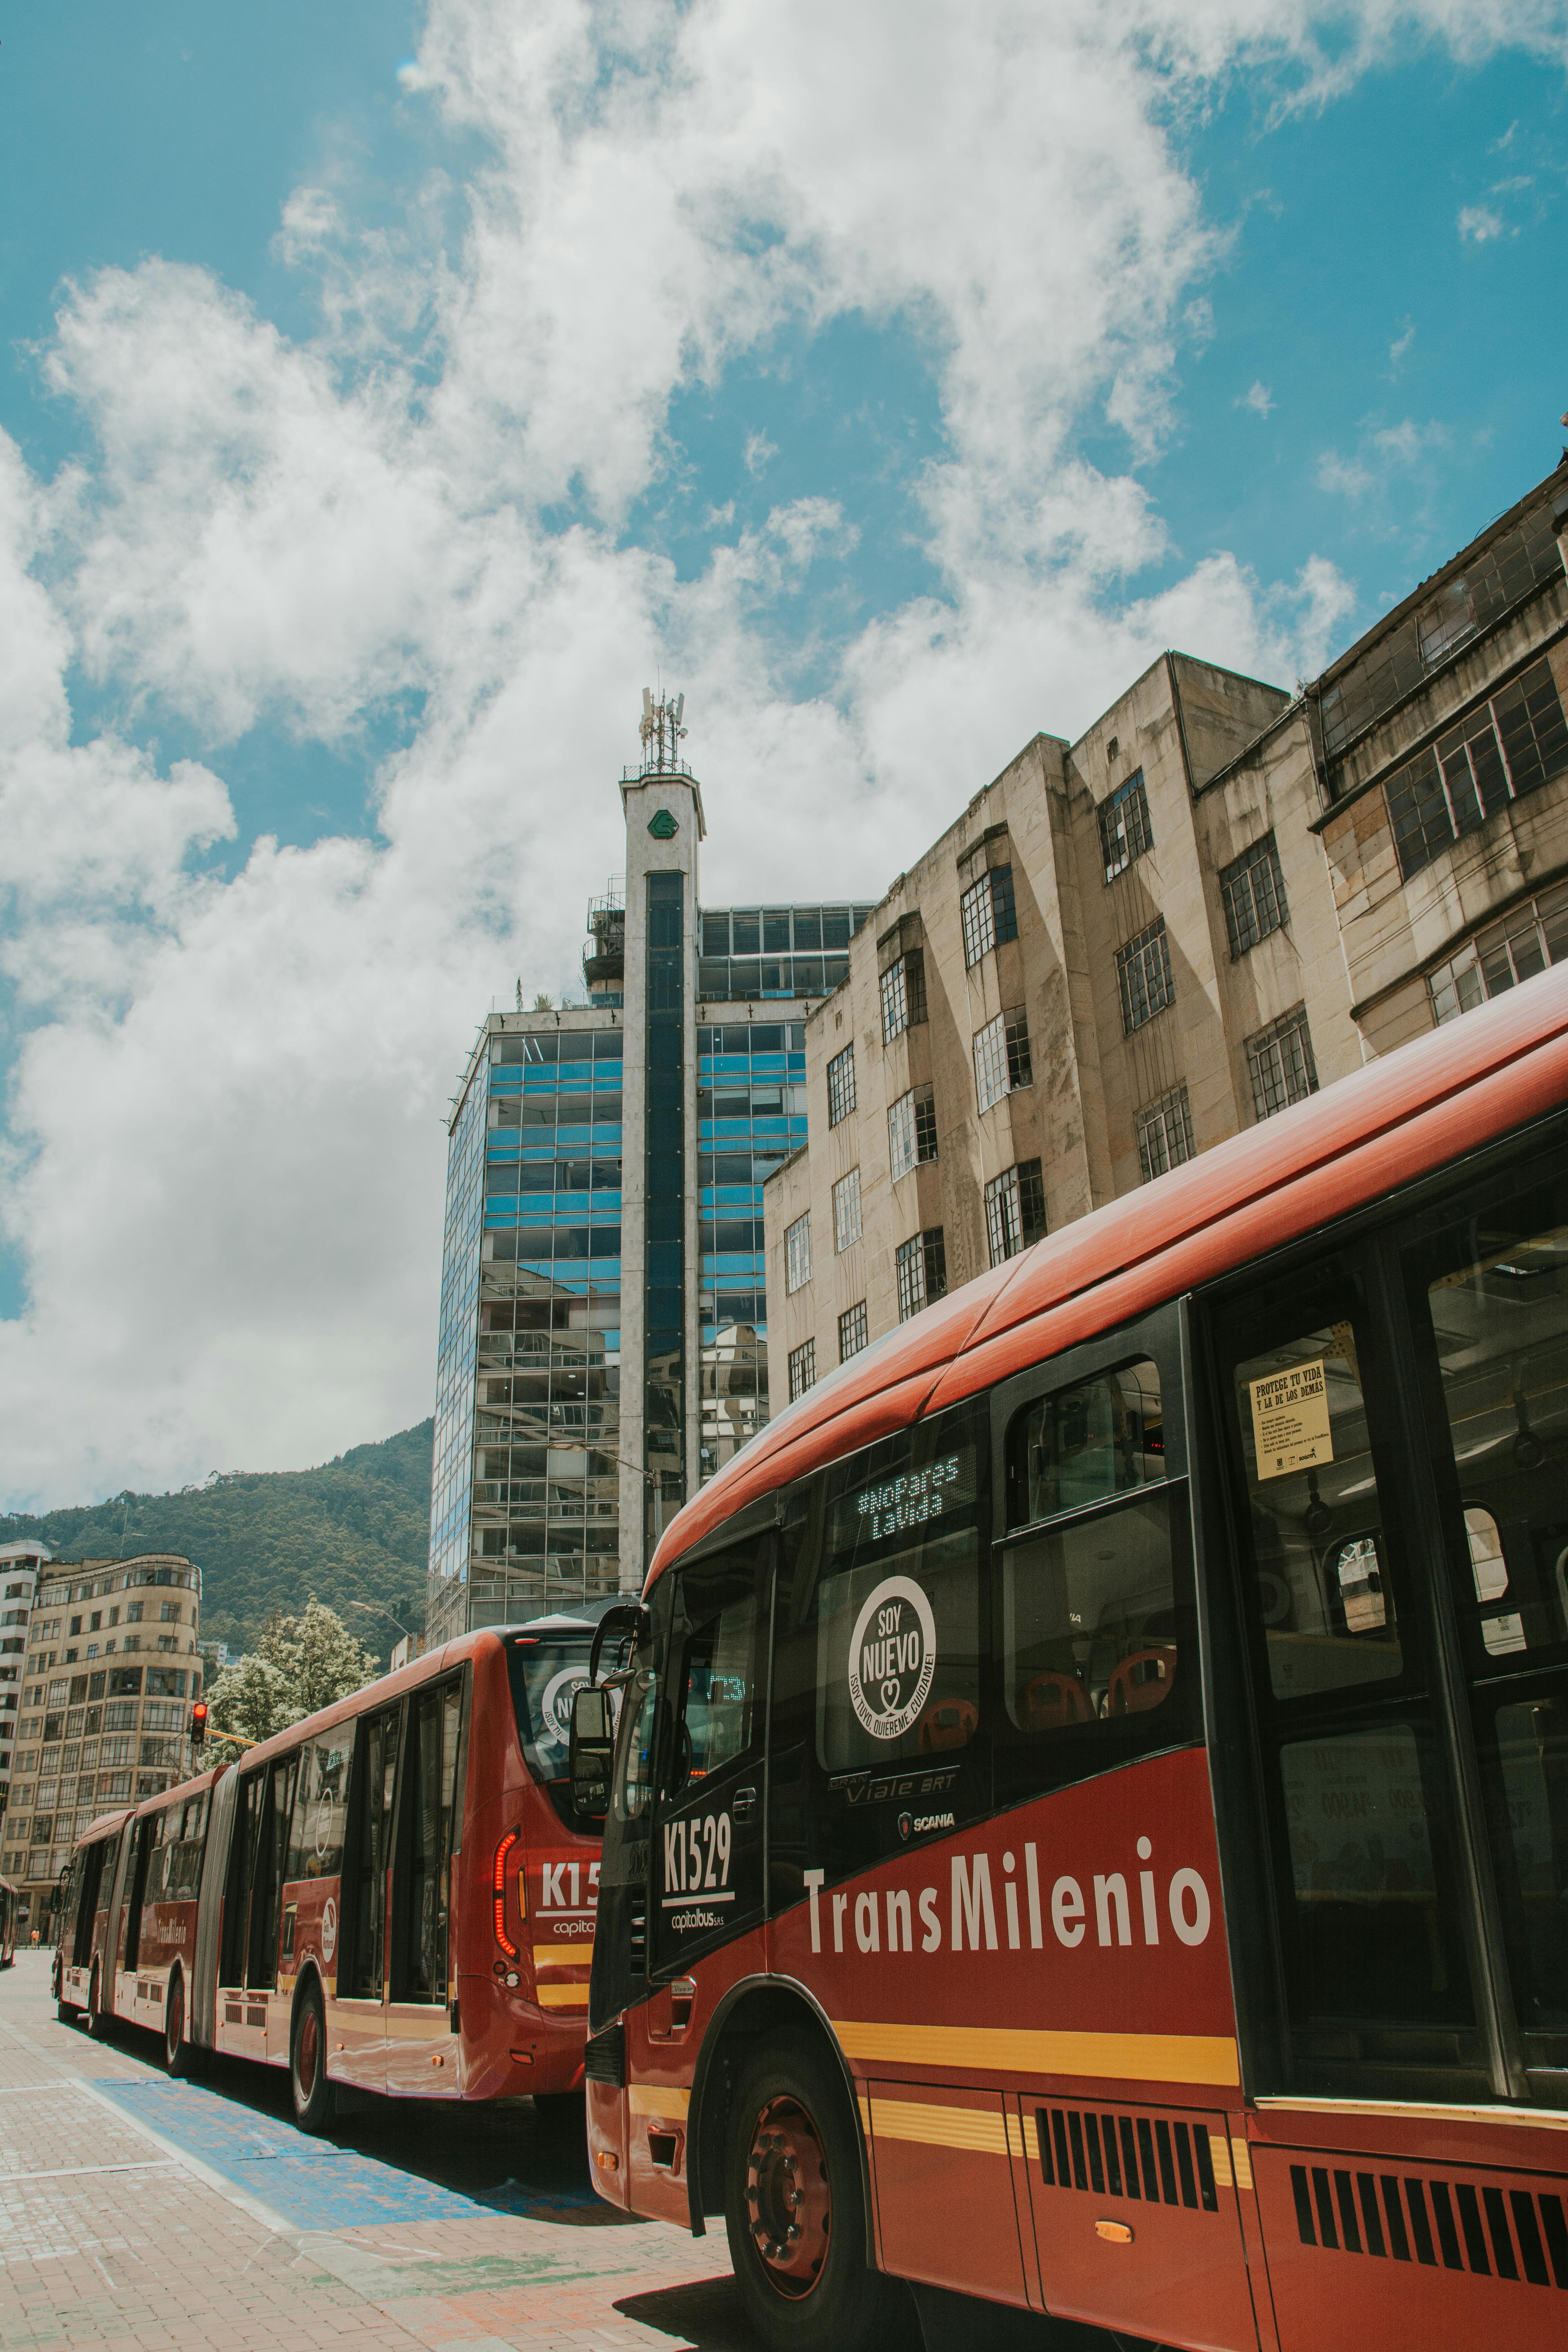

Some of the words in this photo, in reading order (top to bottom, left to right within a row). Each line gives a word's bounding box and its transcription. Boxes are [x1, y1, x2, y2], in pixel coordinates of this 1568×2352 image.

[1256, 1377, 1288, 1398] PROTEGE
[1290, 1373, 1300, 1387] TU
[1302, 1366, 1322, 1383] VIDA
[1257, 1400, 1261, 1411] Y
[1264, 1397, 1273, 1409] LA
[1275, 1393, 1283, 1405] DE
[1286, 1389, 1298, 1402] LOS
[1300, 1380, 1323, 1397] DEMÁS
[858, 1457, 958, 1514] #NoPares
[873, 1495, 942, 1539] LaVida
[878, 1604, 902, 1637] SOY
[863, 1630, 919, 1684] NUEVO
[850, 1673, 861, 1701] ¡SOY
[857, 1699, 873, 1730] TUYO,
[873, 1710, 913, 1736] QUIÉREME,
[911, 1653, 934, 1714] CUÍDAME!
[846, 1779, 913, 1803] Viale
[921, 1773, 956, 1793] BRT
[914, 1813, 955, 1831] SCANIA
[664, 1812, 731, 1893] K1529
[543, 1862, 601, 1906] K15
[804, 1836, 1211, 1954] TransMilenio
[157, 1916, 186, 1944] TransMilenio
[554, 1920, 595, 1937] capita
[672, 1907, 714, 1934] capitalbus
